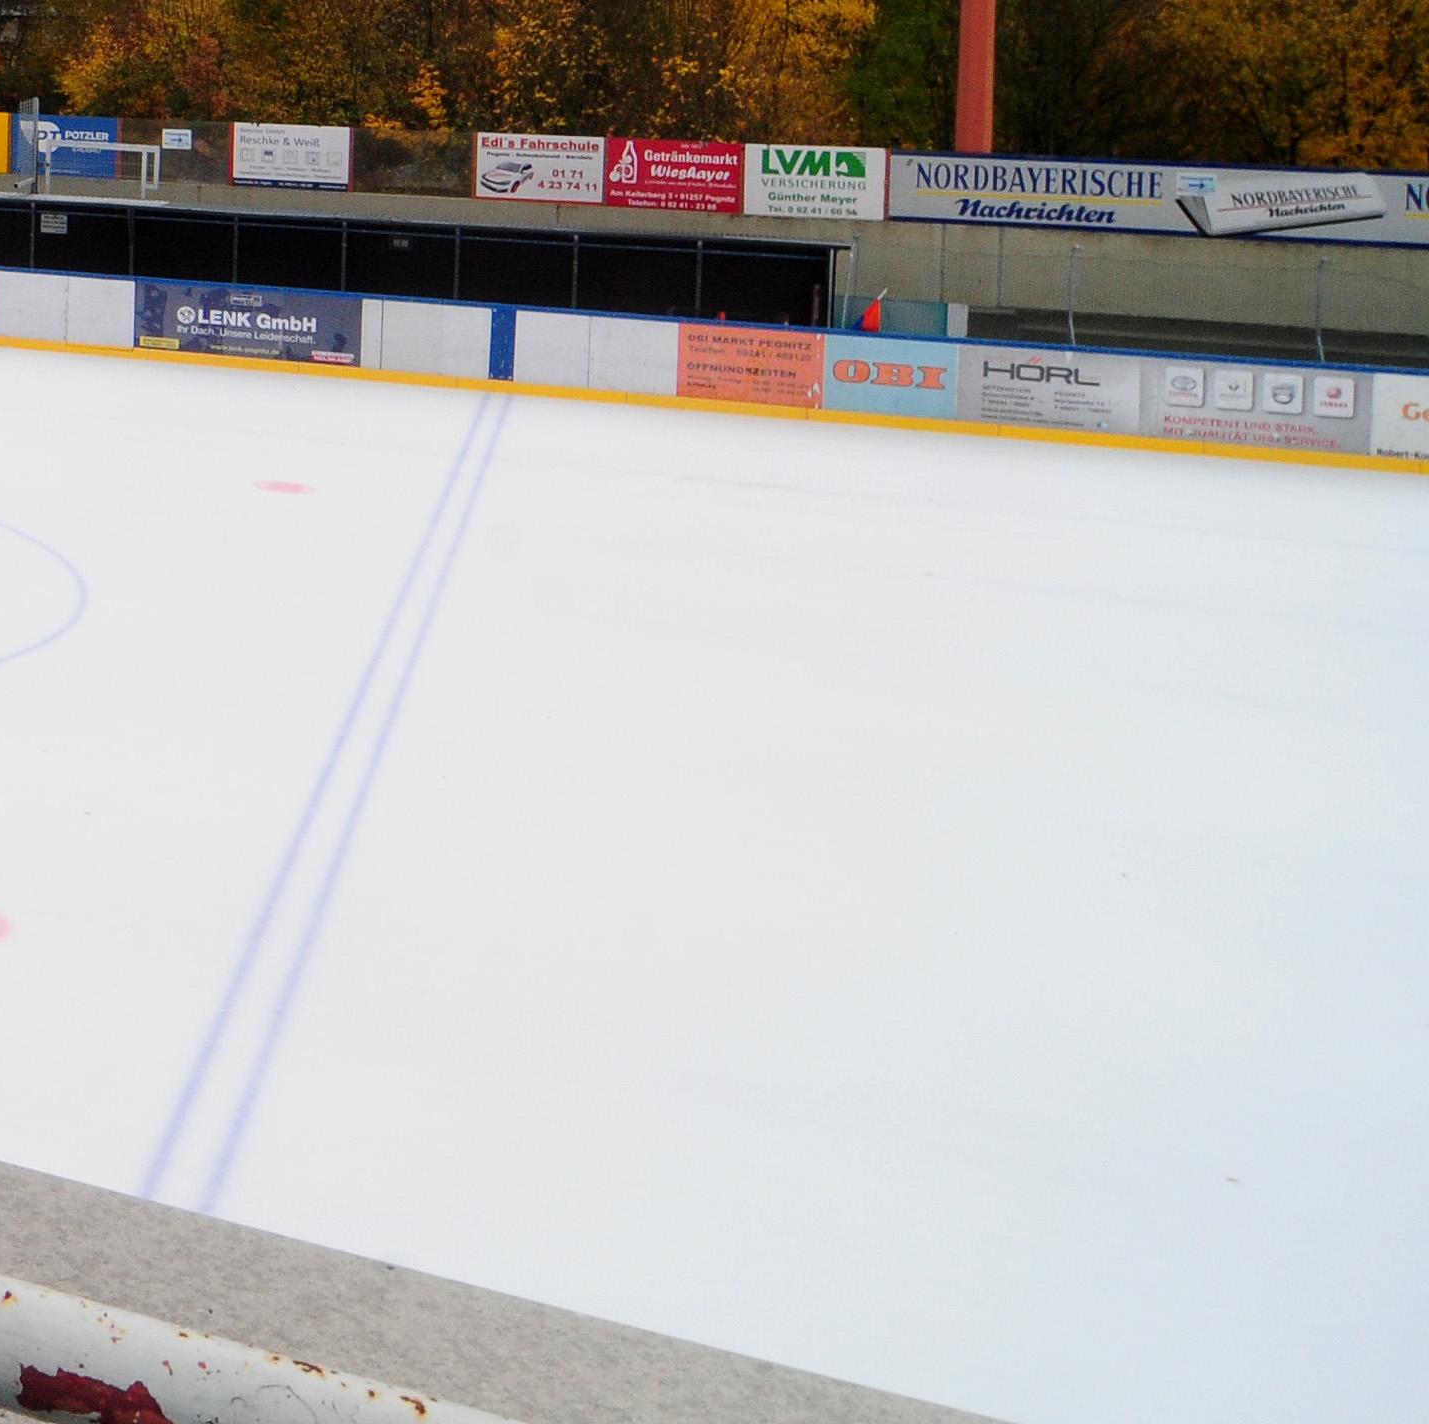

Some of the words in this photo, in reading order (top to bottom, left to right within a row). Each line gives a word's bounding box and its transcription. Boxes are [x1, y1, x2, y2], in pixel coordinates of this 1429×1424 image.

[240, 135, 280, 146] Reschke
[282, 138, 290, 146] &
[293, 138, 320, 147] Weiß
[520, 138, 599, 152] Fahrschule
[643, 149, 739, 166] Getränkemarkt
[761, 149, 831, 176] LVM
[552, 169, 565, 178] 01
[570, 170, 583, 179] 71
[917, 162, 1163, 199] NORDBAYERISCHE
[538, 180, 545, 189] 4
[548, 181, 562, 190] 23
[566, 182, 580, 191] 74
[585, 183, 597, 192] 11
[761, 177, 866, 191] VERSICHERUNG
[767, 191, 816, 202] Günther
[820, 193, 858, 207] Meyer
[1230, 184, 1359, 208] NORDBAYERISCHE
[955, 197, 1116, 224] Nachrichten
[1267, 202, 1345, 218] Nachrichten
[198, 309, 251, 328] LENK
[256, 313, 317, 333] GmbH
[177, 324, 188, 333] Ihr
[191, 325, 217, 335] Dach.
[219, 328, 252, 339] Unsere
[254, 331, 316, 345] Leidenschaft.
[712, 336, 754, 347] MARKT
[759, 340, 813, 350] PEGNITZ
[687, 361, 797, 378] ÖFFNUNGSZEITEN
[832, 358, 948, 390] OBI
[1164, 415, 1240, 428] KOMPETENT
